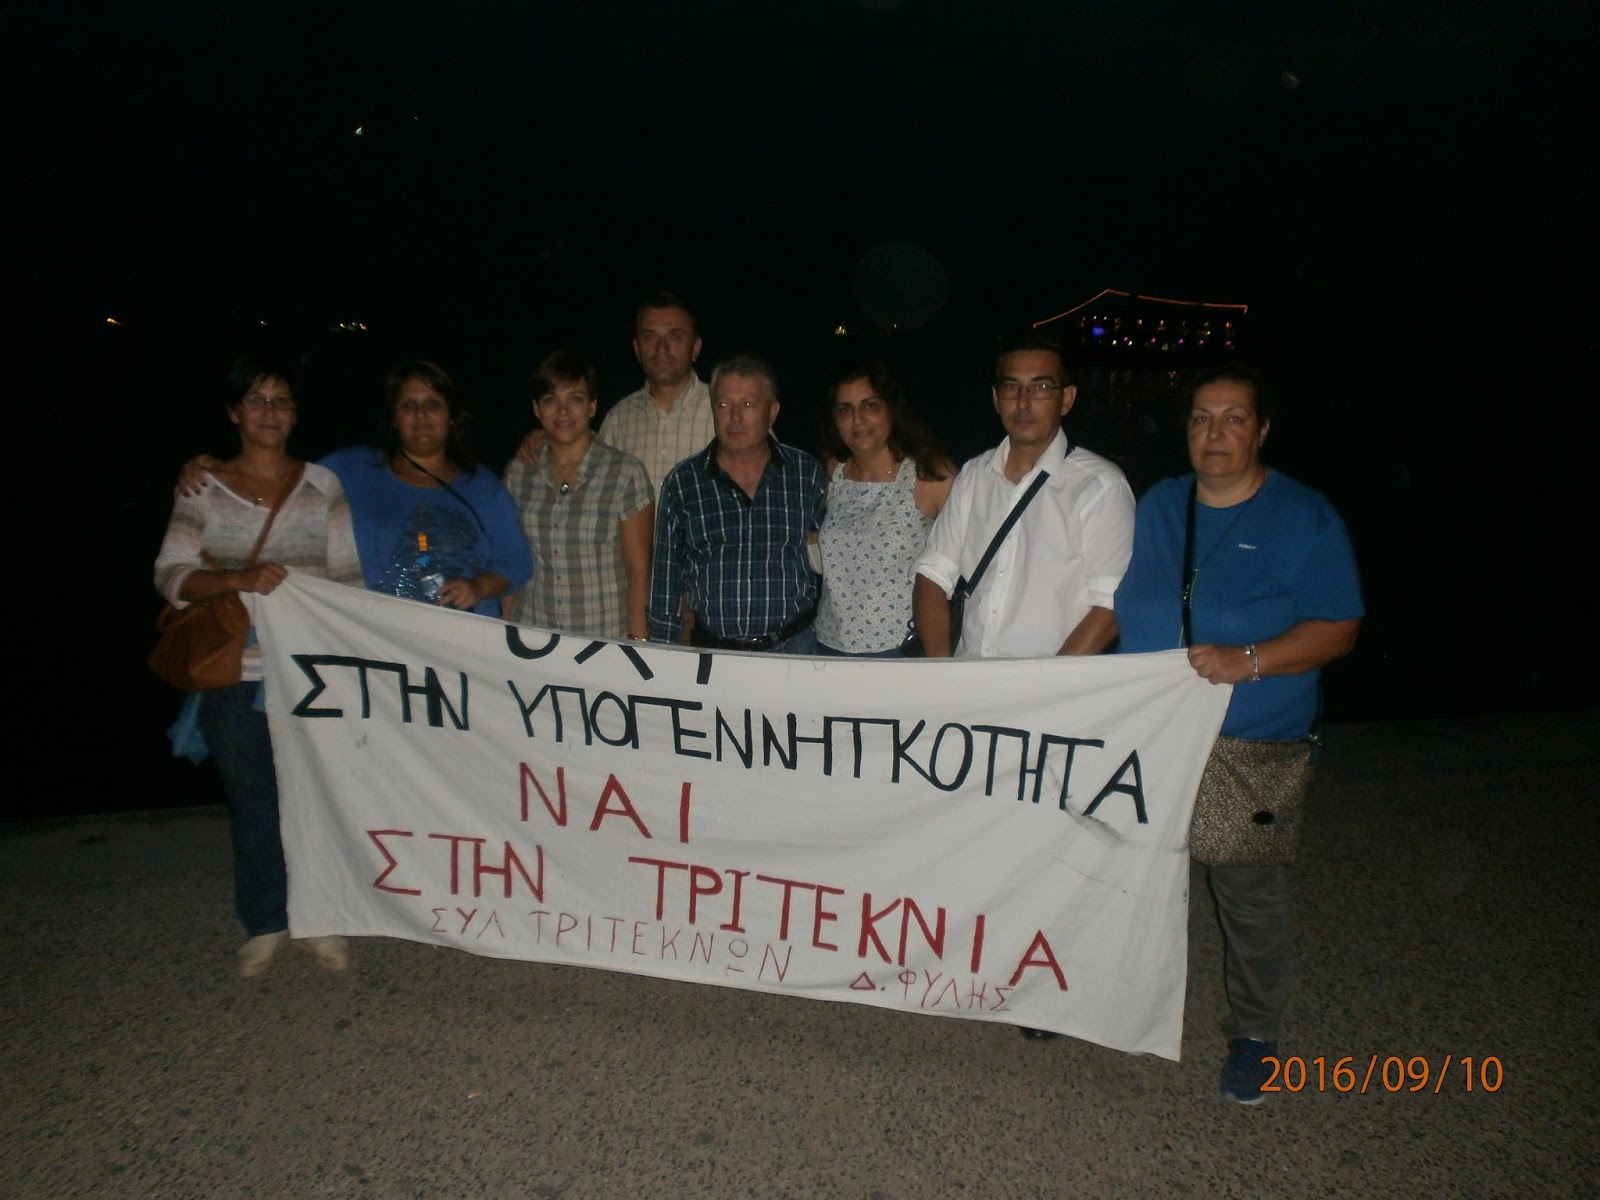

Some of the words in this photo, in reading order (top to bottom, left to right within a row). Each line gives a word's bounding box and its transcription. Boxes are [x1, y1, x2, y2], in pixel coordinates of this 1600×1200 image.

[290, 653, 470, 731] ΣΤΗΝ
[518, 761, 692, 844] ΝΑΙ
[366, 829, 545, 904] ΣΤΗΝ
[628, 856, 1068, 992] ΤΡΙΤΕΚΝΙΑ
[529, 910, 793, 983] ΤΡΙΤΕΚΝΩΝ
